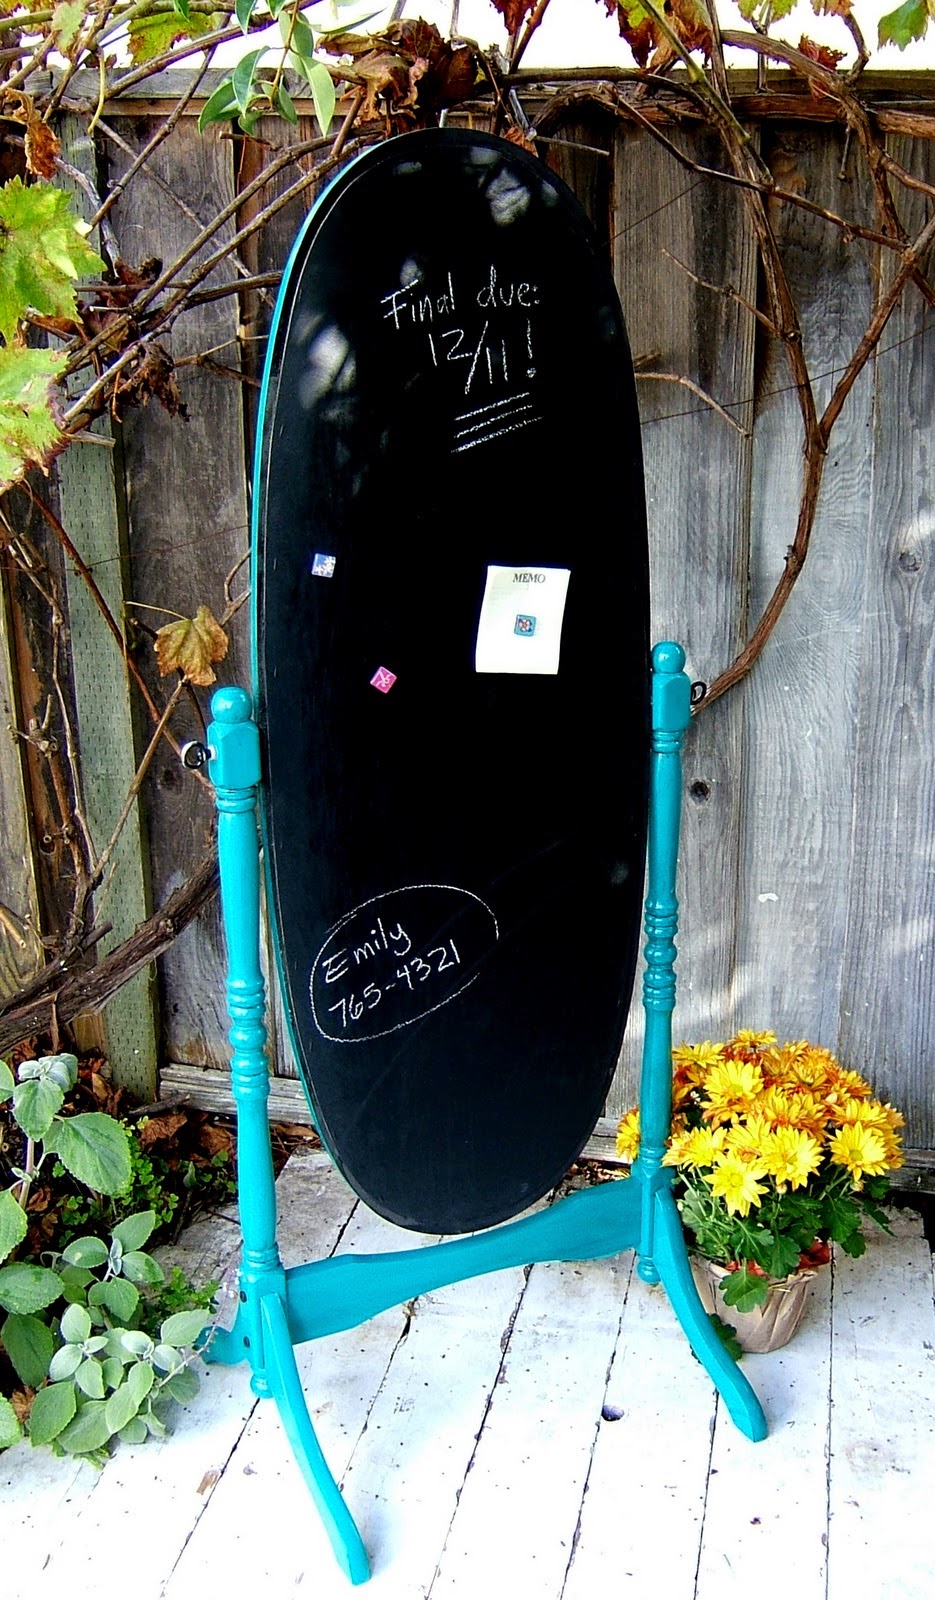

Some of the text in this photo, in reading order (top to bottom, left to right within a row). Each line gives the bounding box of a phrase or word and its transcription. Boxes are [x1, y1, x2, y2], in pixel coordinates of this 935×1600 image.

[381, 271, 455, 330] Final
[512, 573, 546, 583] MEMO
[321, 917, 412, 984] Emily
[328, 939, 460, 1028] 765-4321
